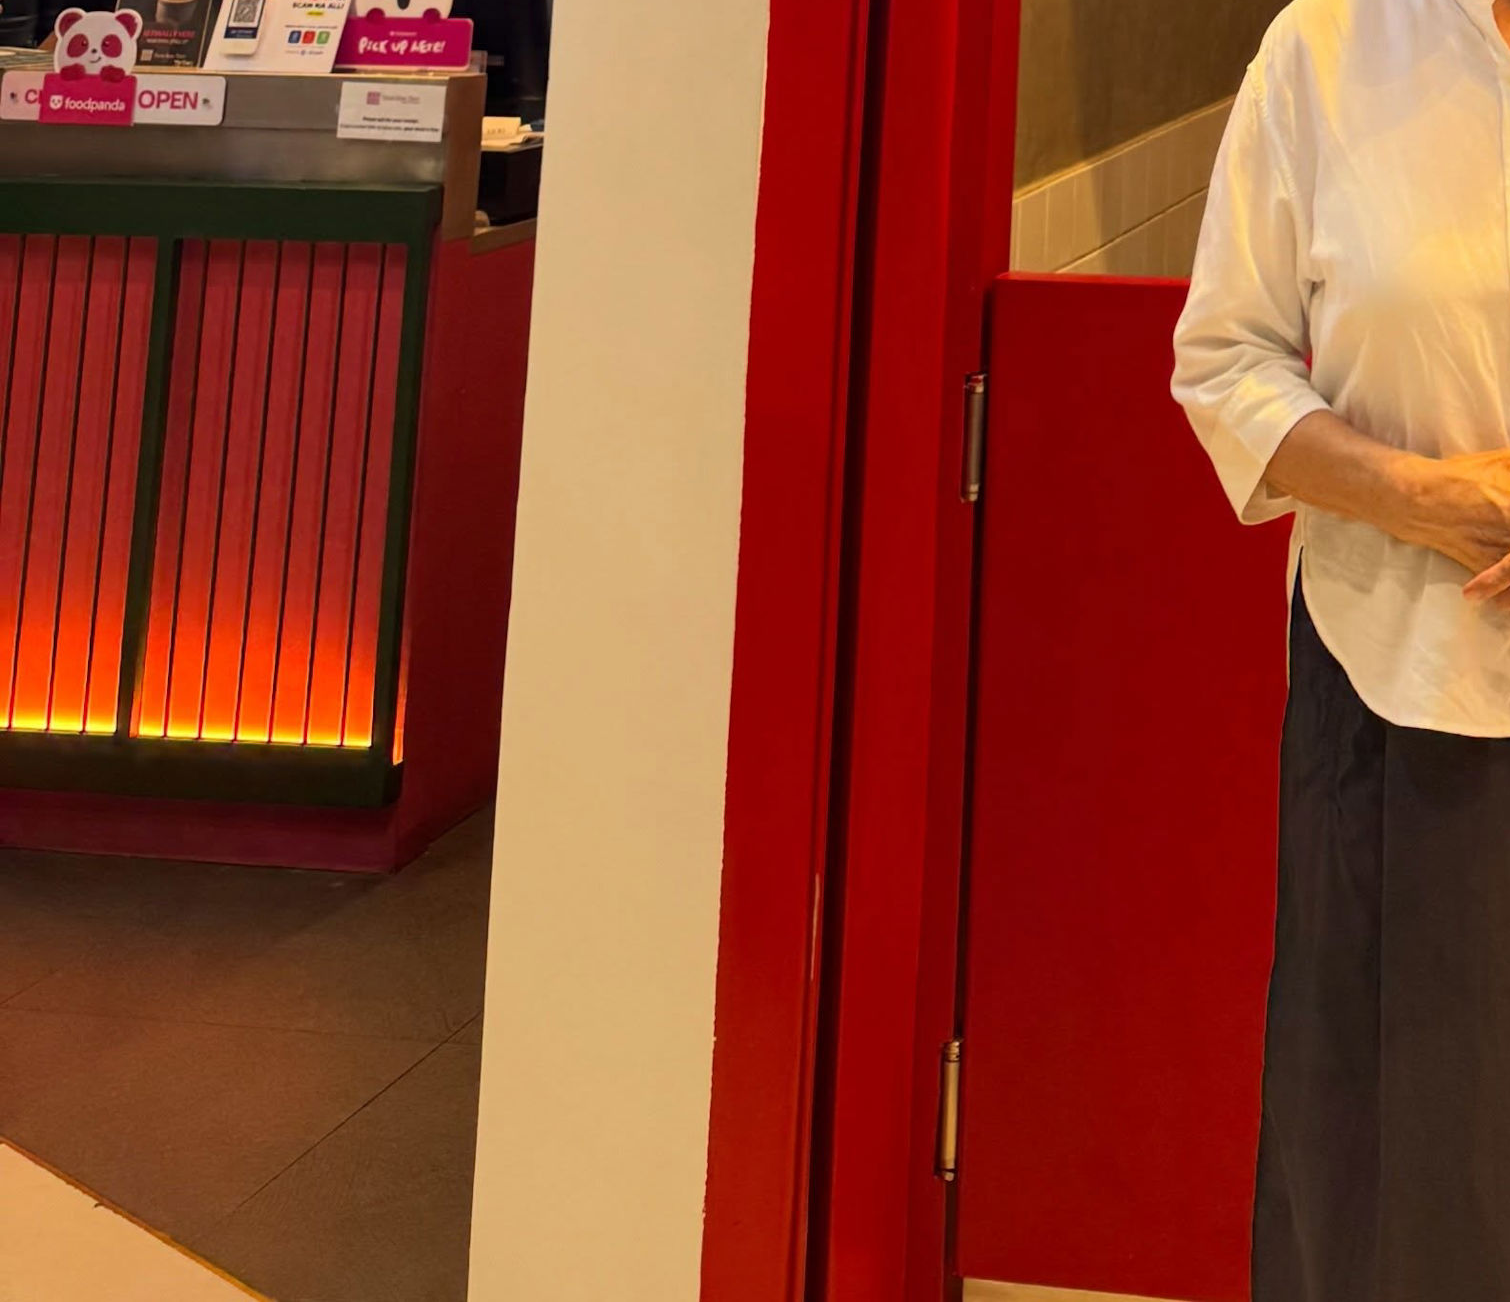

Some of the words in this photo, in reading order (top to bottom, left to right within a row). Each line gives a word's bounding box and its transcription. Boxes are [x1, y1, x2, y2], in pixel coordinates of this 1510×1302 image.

[358, 36, 388, 55] PICK
[391, 39, 408, 55] UP
[64, 97, 125, 113] foodpanda
[138, 90, 199, 110] OPEN
